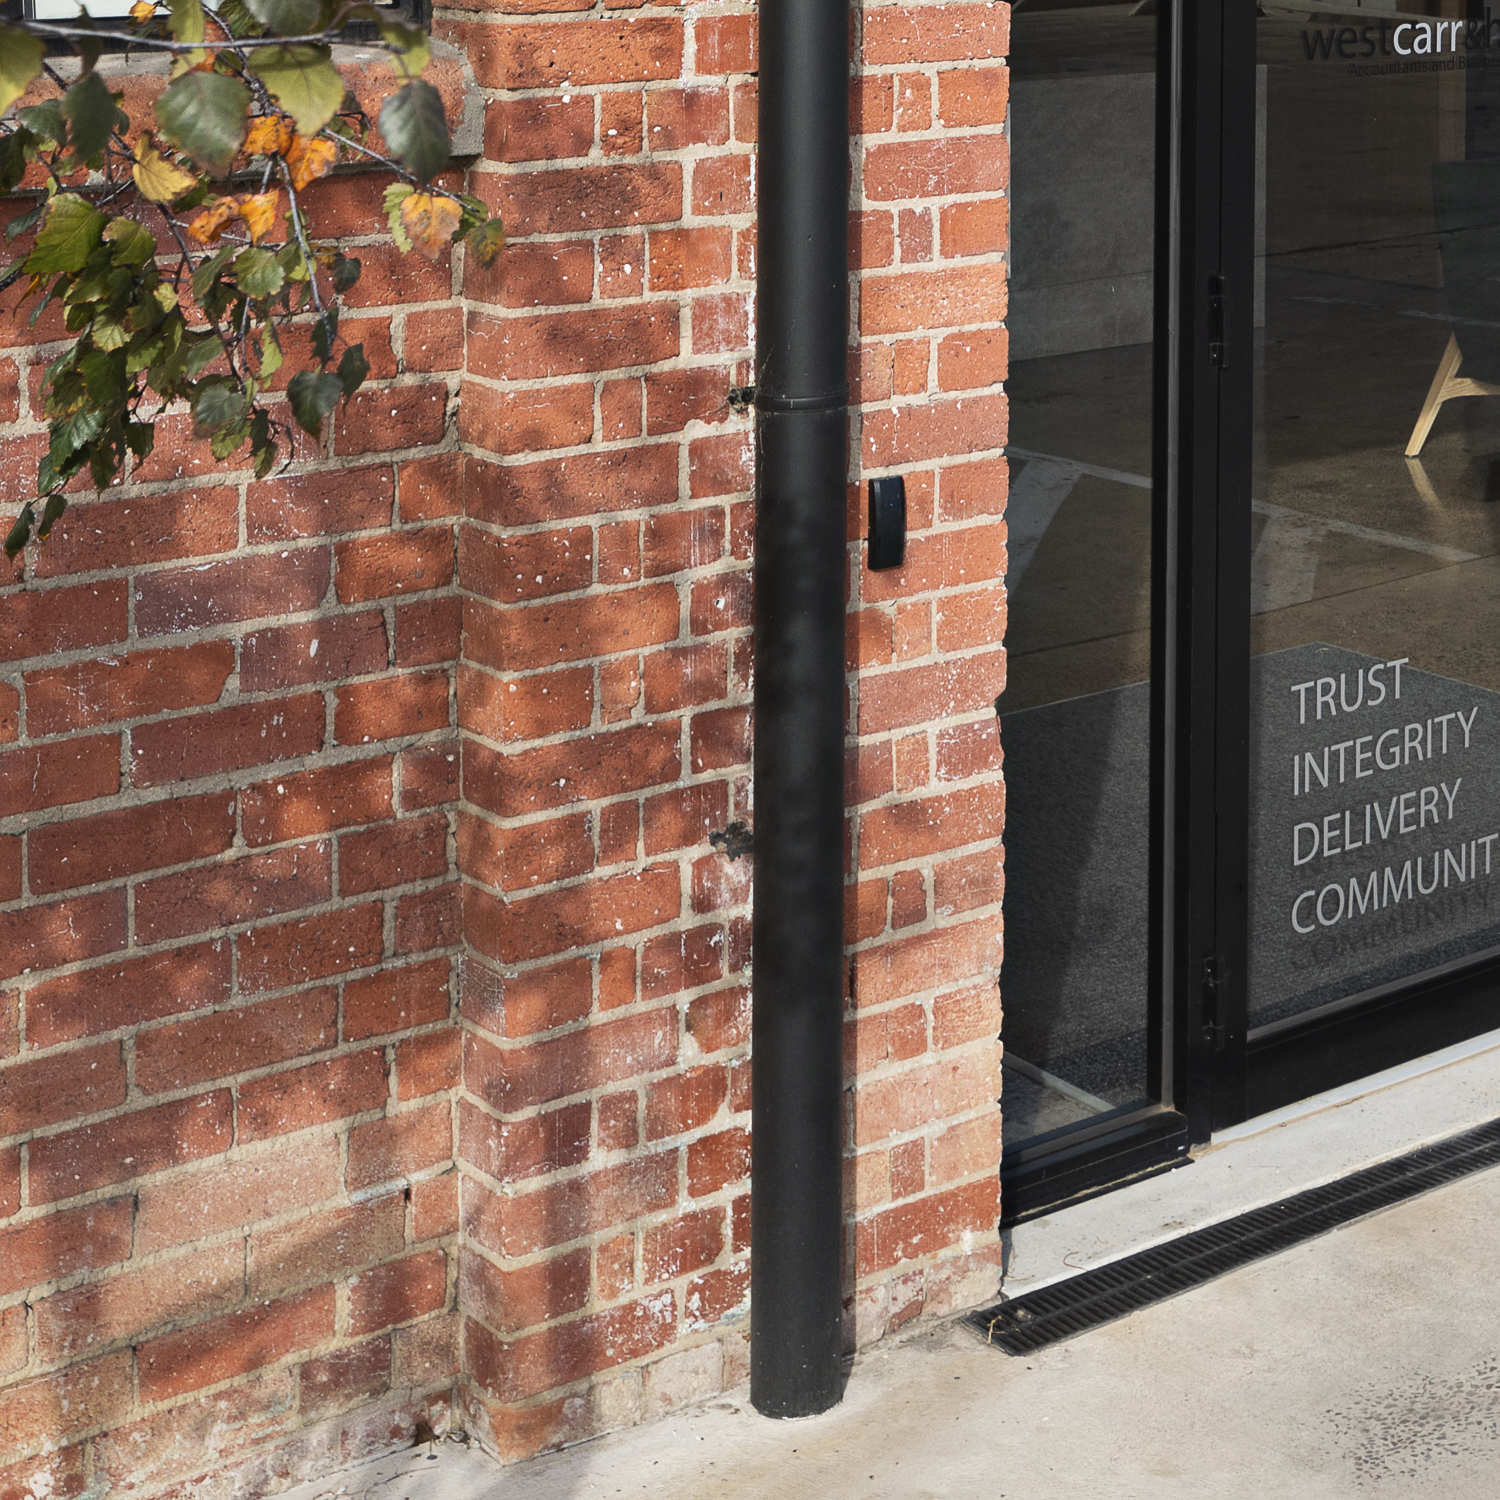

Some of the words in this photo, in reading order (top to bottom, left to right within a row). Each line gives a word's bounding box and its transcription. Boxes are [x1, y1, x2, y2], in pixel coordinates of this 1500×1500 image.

[1348, 60, 1428, 77] Accountants
[1430, 56, 1454, 72] and
[1290, 657, 1409, 725] TRUST
[1293, 706, 1478, 796] INTEGRITY
[1293, 777, 1462, 866] DELIVERY
